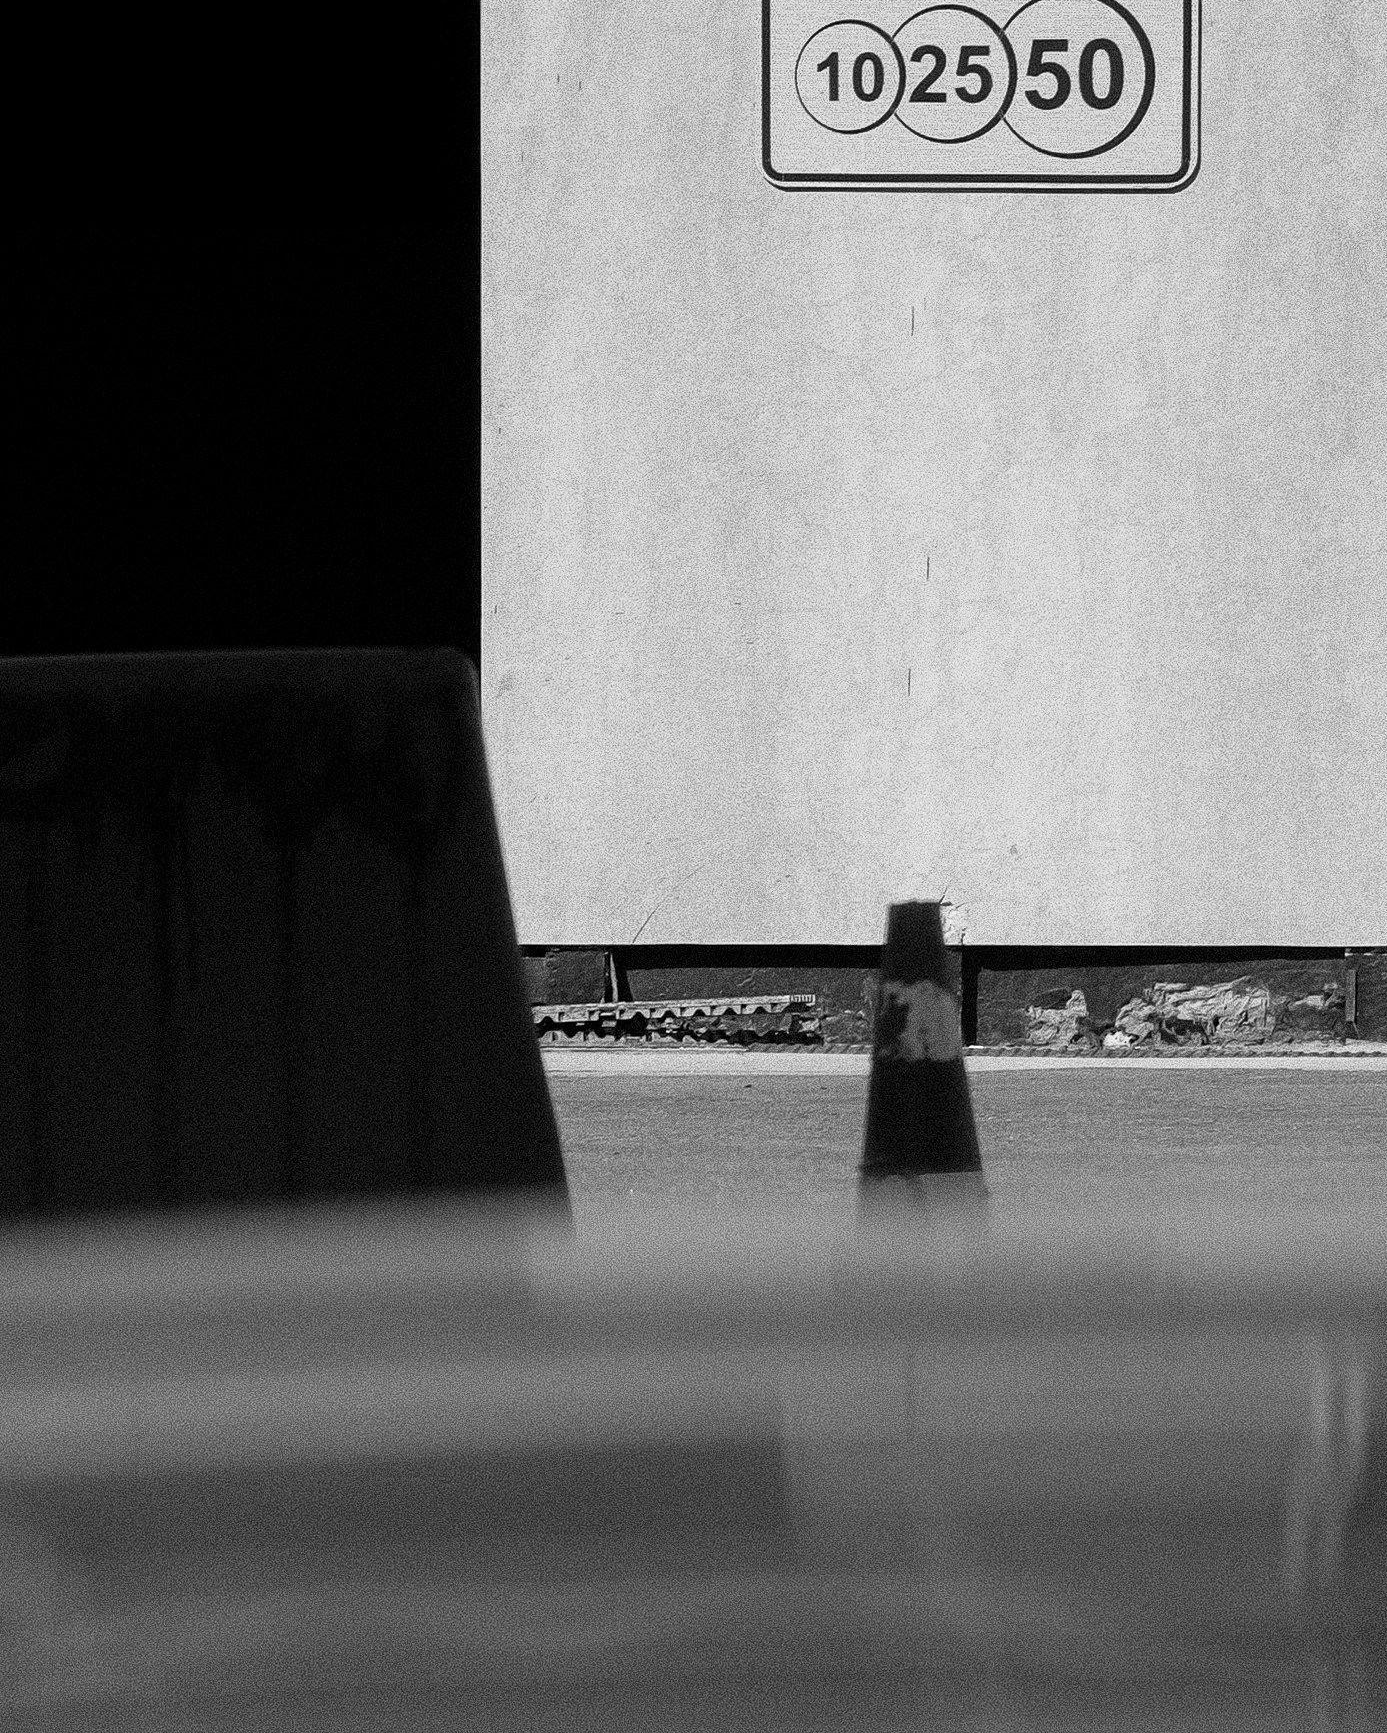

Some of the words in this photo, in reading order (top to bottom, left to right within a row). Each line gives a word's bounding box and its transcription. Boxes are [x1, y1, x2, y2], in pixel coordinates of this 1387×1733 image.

[817, 51, 885, 102] 10
[909, 44, 993, 104] 25
[1024, 38, 1125, 111] 50
